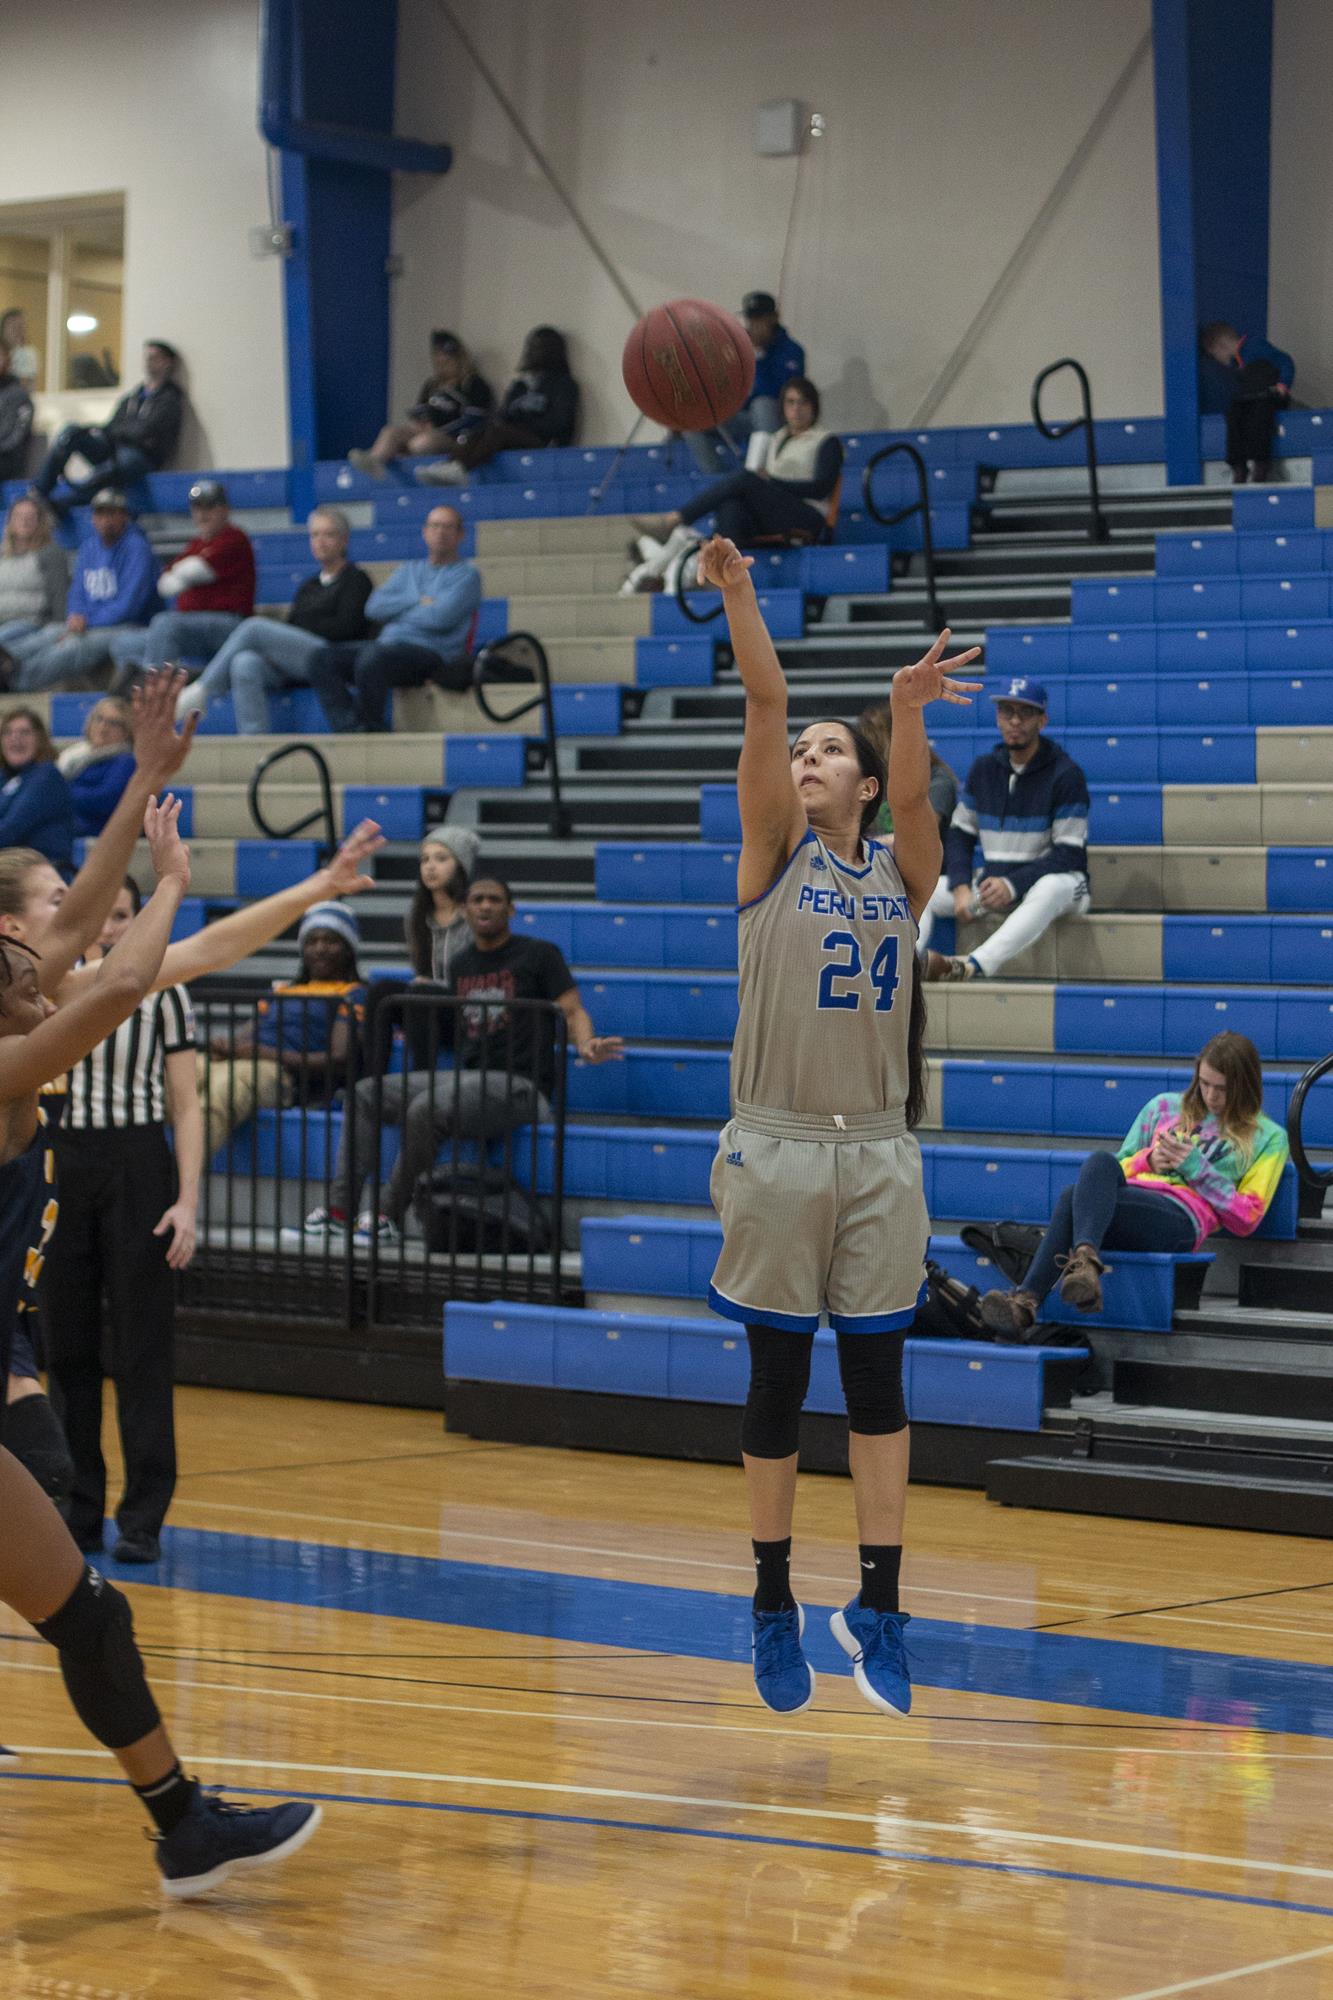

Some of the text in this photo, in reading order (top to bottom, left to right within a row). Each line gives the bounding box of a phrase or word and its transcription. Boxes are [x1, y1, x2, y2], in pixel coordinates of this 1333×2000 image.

[1008, 678, 1027, 697] P
[797, 883, 856, 921] PERU
[816, 929, 900, 1013] 24
